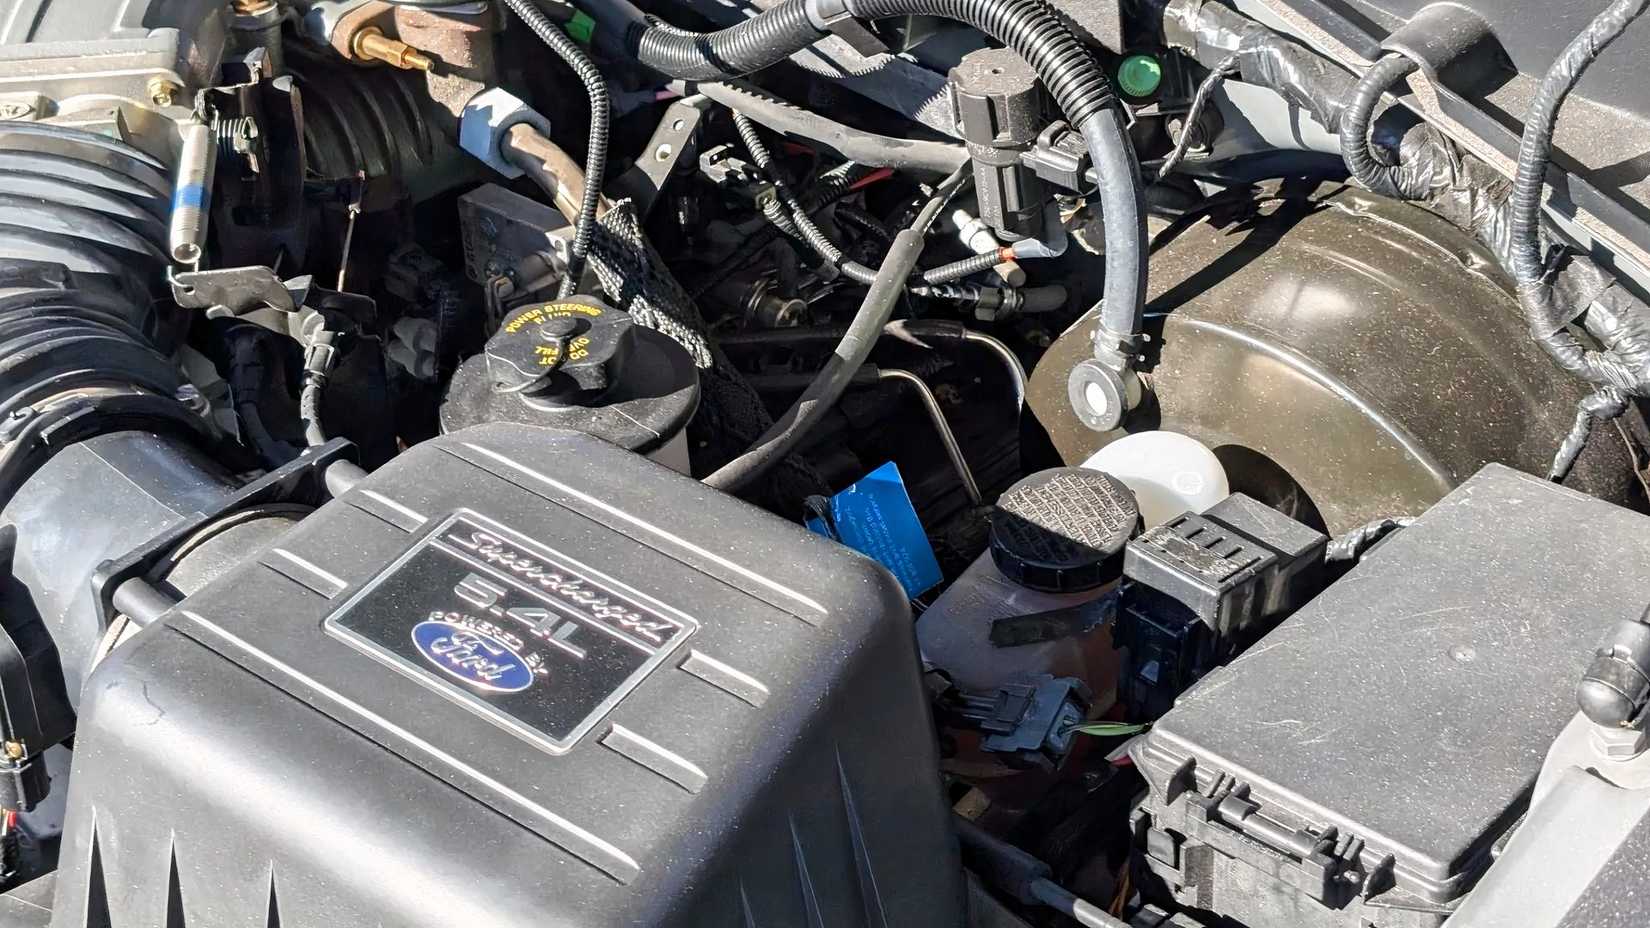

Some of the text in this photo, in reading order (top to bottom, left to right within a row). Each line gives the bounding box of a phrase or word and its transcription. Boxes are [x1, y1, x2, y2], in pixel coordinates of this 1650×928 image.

[505, 303, 602, 333] POWER STEERING
[448, 532, 673, 642] Supercharged
[454, 572, 587, 659] 5.4L
[428, 611, 549, 675] POWERED BY
[430, 631, 516, 681] Ford
